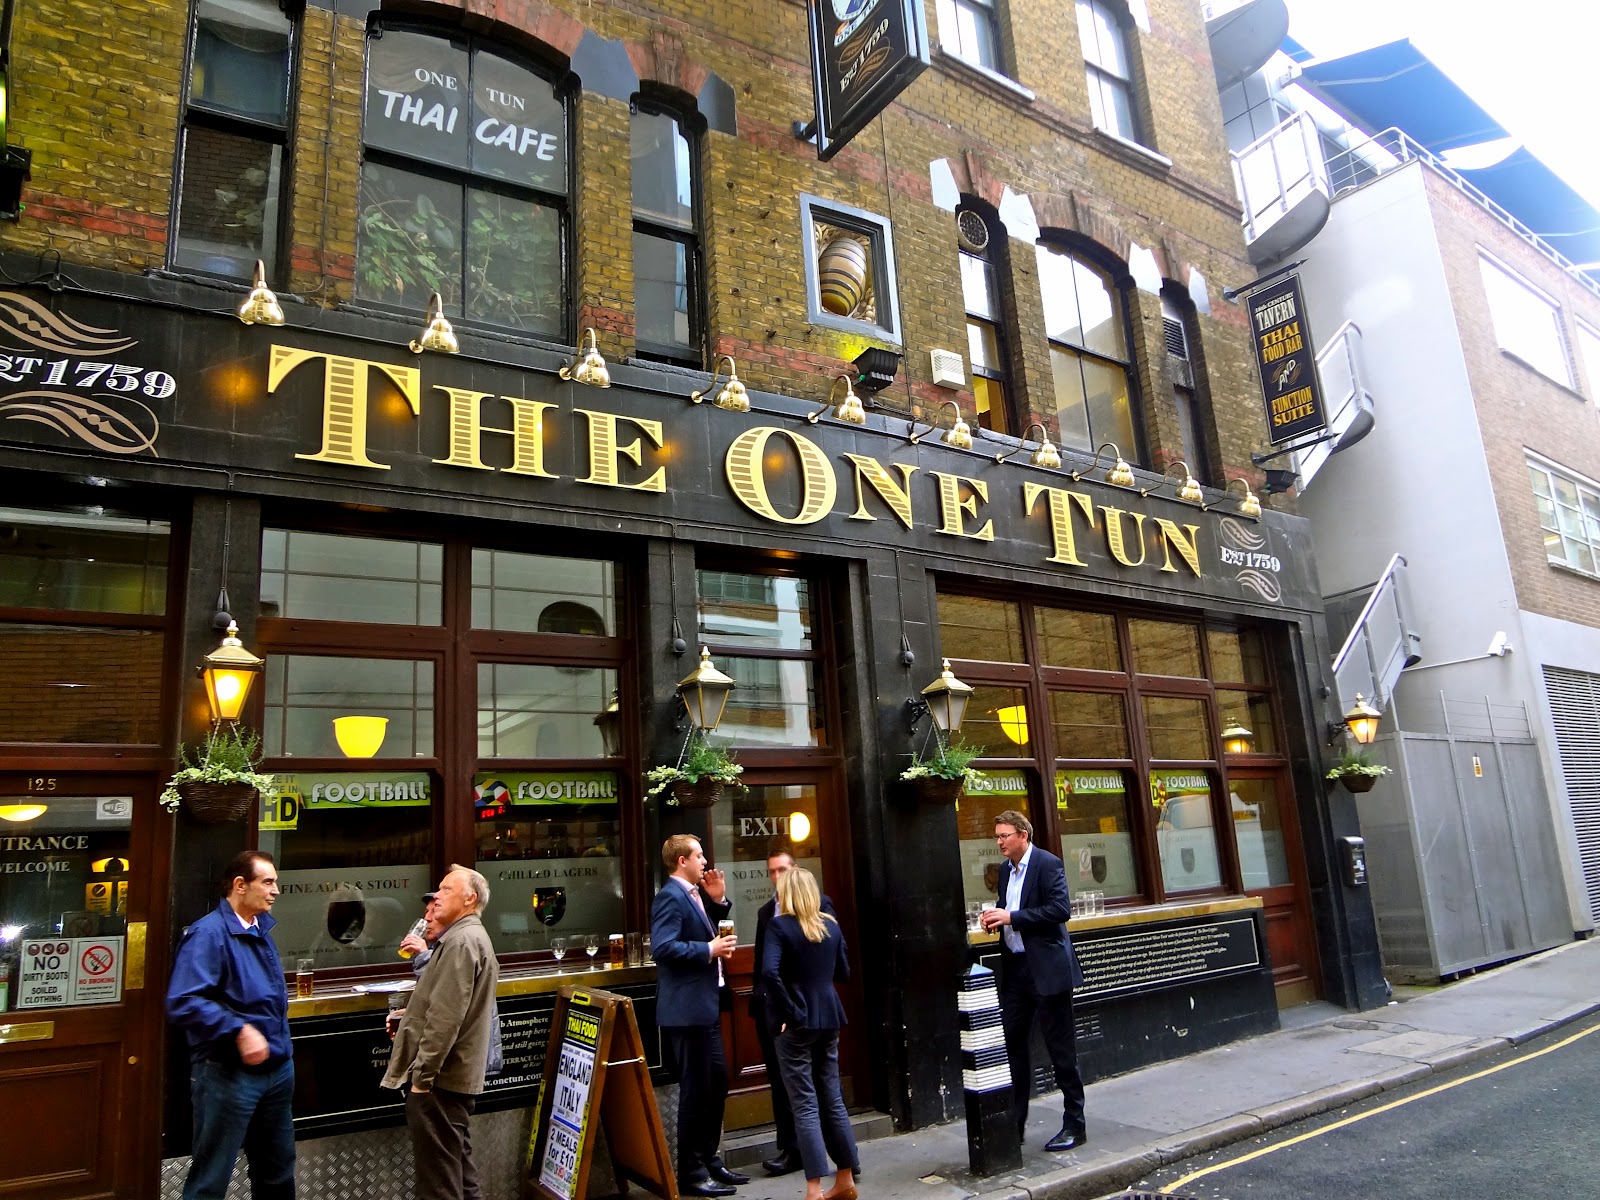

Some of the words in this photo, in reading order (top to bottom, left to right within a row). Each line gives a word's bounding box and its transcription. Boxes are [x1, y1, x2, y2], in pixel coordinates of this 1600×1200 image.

[414, 68, 458, 92] ONE
[485, 87, 526, 112] TUN
[378, 89, 459, 134] THAI
[475, 117, 558, 161] CAFE
[1255, 298, 1297, 332] TAVERN
[1261, 321, 1300, 348] THAI
[1262, 342, 1286, 364] FOOD
[1284, 334, 1303, 355] BAR
[0, 353, 43, 382] ST
[39, 358, 177, 398] 1759
[1278, 359, 1297, 391] AND
[1271, 386, 1313, 416] FUNCTION
[1273, 402, 1315, 427] SUITE
[267, 343, 667, 493] THE
[725, 426, 995, 542] ONE
[1023, 480, 1201, 578] TUN
[1245, 552, 1280, 572] 1759
[27, 778, 57, 790] 125
[517, 780, 615, 800] FOOTBALL
[1074, 775, 1124, 790] FOOTBALL
[1165, 775, 1209, 788] FOOTBALL
[260, 796, 297, 822] HD
[311, 781, 427, 803] FOOTBALL
[740, 816, 791, 836] EXIT
[0, 835, 89, 850] TRANCE
[499, 869, 551, 880] CHILLED
[554, 867, 598, 878] LAGERS
[732, 870, 747, 880] NO
[281, 884, 313, 894] FINE
[315, 881, 350, 893] ALES
[354, 880, 364, 891] &
[367, 878, 410, 890] STOUT
[33, 956, 61, 970] NO
[24, 972, 45, 981] DIRTY
[46, 971, 69, 981] BOOTS
[24, 995, 63, 1004] CLOTHING
[31, 986, 58, 995] SOILED
[506, 1017, 549, 1027] Atmosphere
[567, 1016, 582, 1034] THAI
[580, 1020, 598, 1039] FOOD
[372, 1046, 391, 1054] Good
[522, 1030, 533, 1039] tap
[514, 1040, 528, 1049] still
[528, 1039, 546, 1049] going
[558, 1053, 593, 1086] ENGLAND
[560, 1085, 582, 1114] ITALY
[550, 1127, 557, 1141] 2
[556, 1130, 578, 1154] MEALS
[548, 1142, 560, 1160] for
[560, 1150, 575, 1171] £10
